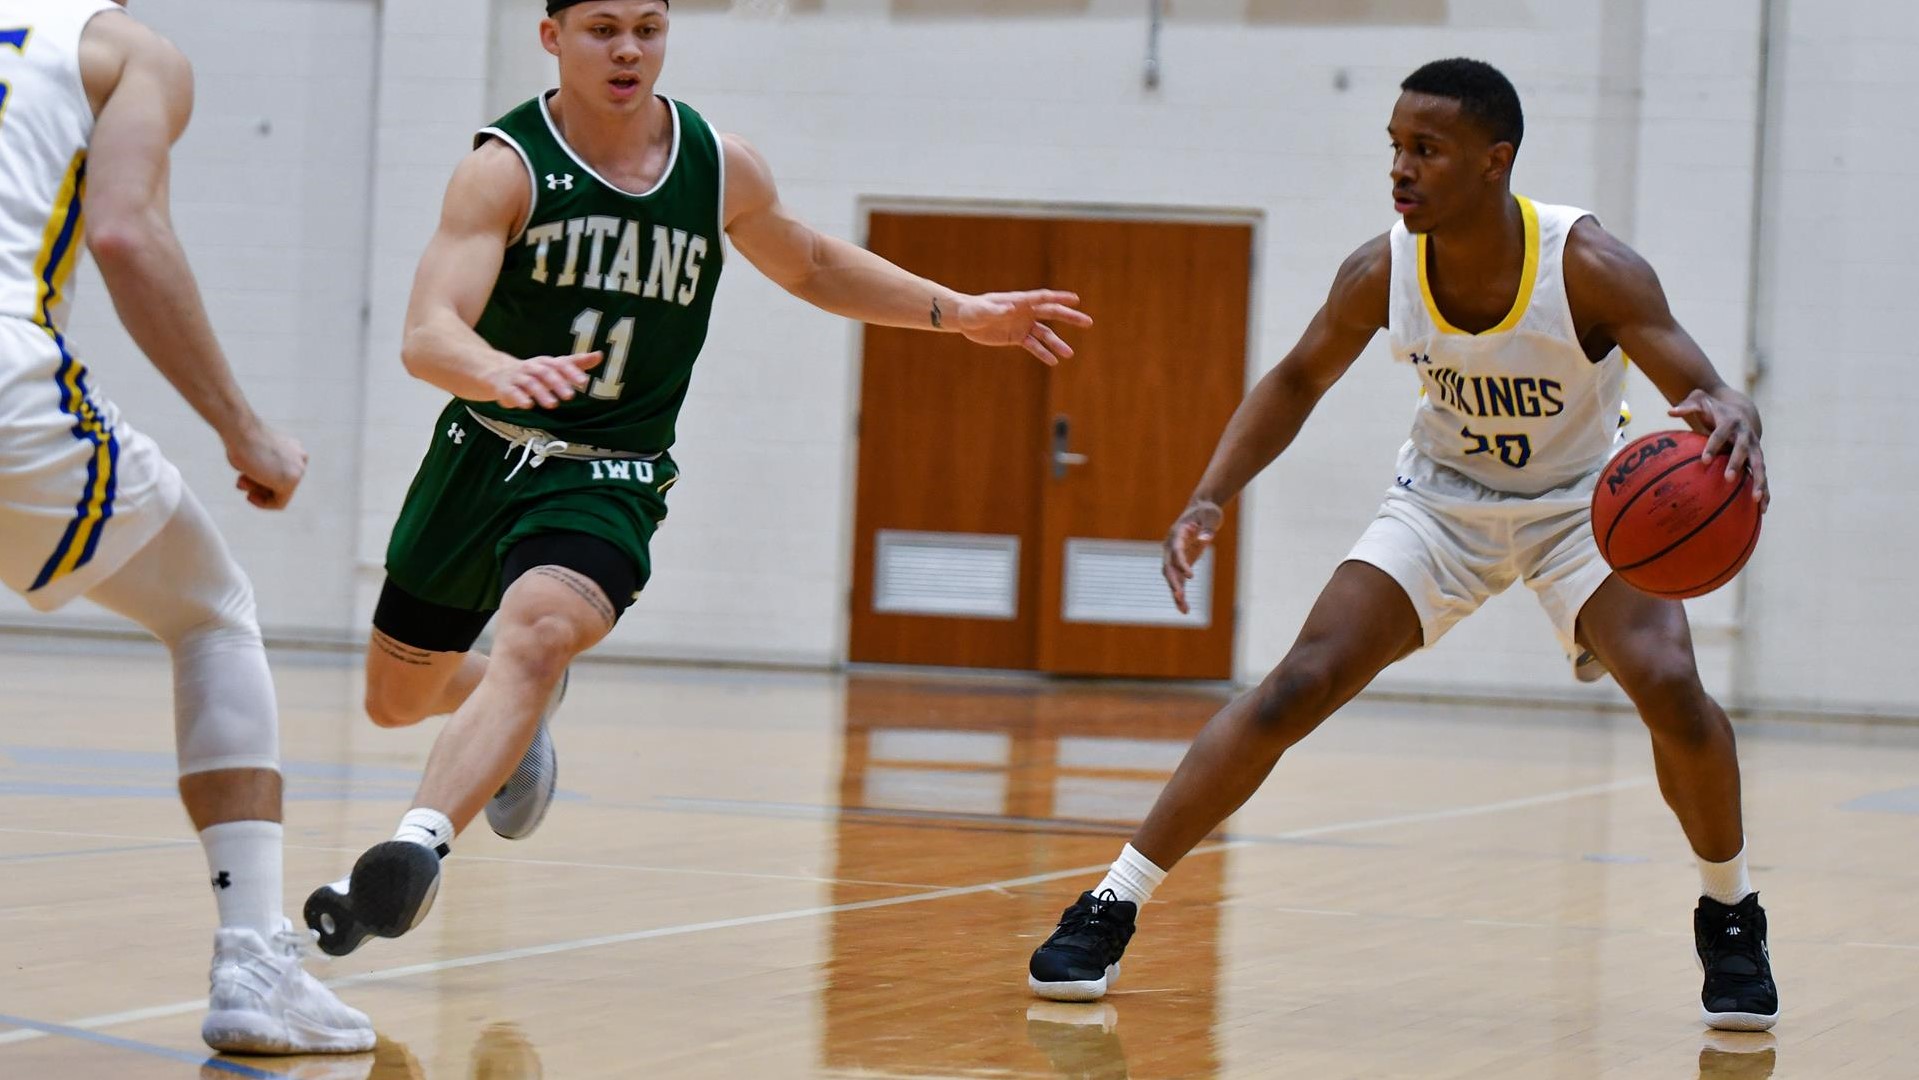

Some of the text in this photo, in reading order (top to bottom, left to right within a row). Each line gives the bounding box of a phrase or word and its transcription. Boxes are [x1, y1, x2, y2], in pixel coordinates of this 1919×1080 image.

[526, 215, 707, 306] TITANS
[569, 307, 635, 400] 11
[1428, 367, 1564, 418] VIKINGS
[589, 460, 654, 483] IWU
[1606, 436, 1678, 496] NCAA
